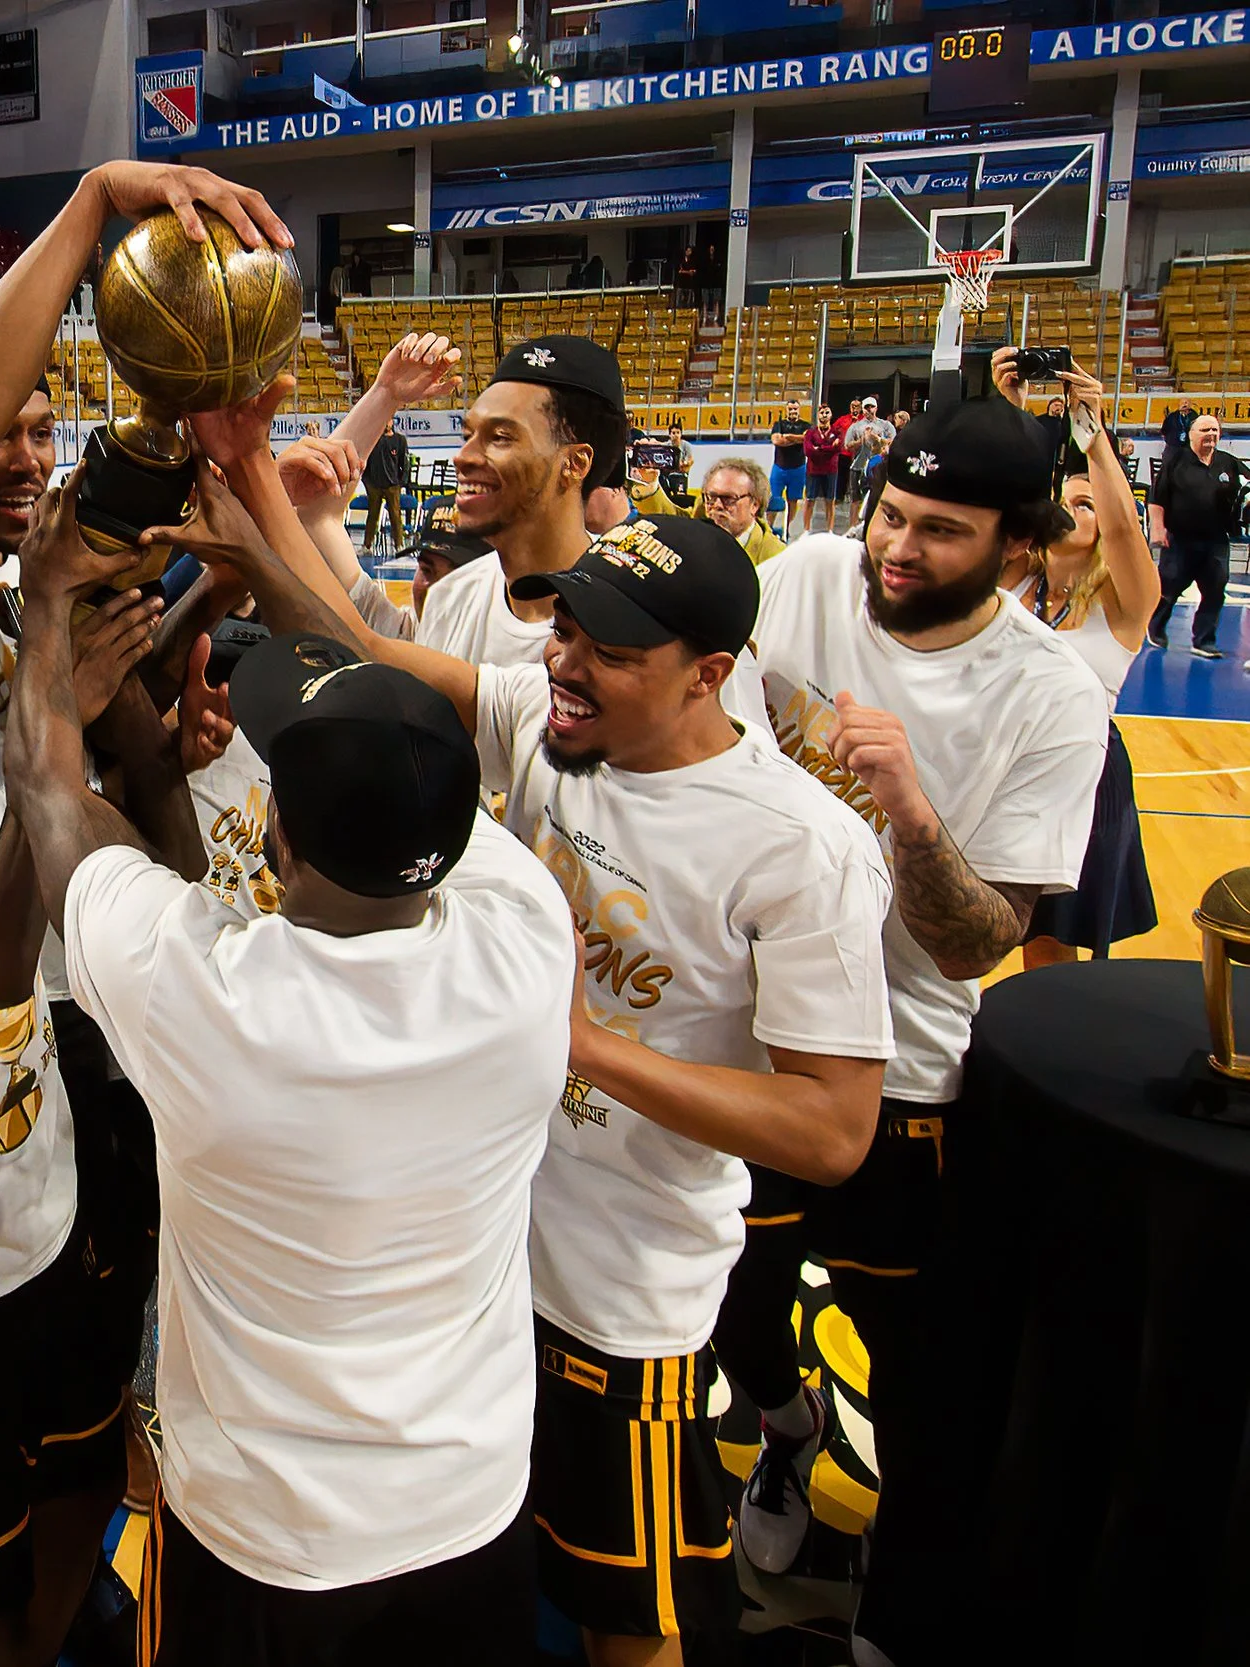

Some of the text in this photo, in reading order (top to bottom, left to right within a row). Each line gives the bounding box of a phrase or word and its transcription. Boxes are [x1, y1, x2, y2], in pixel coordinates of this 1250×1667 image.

[940, 32, 1003, 61] 00.0
[144, 70, 195, 92] KITCHENER
[218, 120, 270, 147] THE
[281, 112, 341, 141] AUD
[373, 98, 463, 131] HOME
[475, 91, 517, 120] OF
[527, 83, 591, 115] THE
[603, 60, 803, 107] KITCHENER
[819, 46, 928, 83] RANG
[1050, 30, 1075, 60] A
[1093, 11, 1246, 56] HOCKE
[1147, 160, 1197, 173] Quality
[483, 200, 589, 226] CSN
[573, 830, 606, 857] 2022
